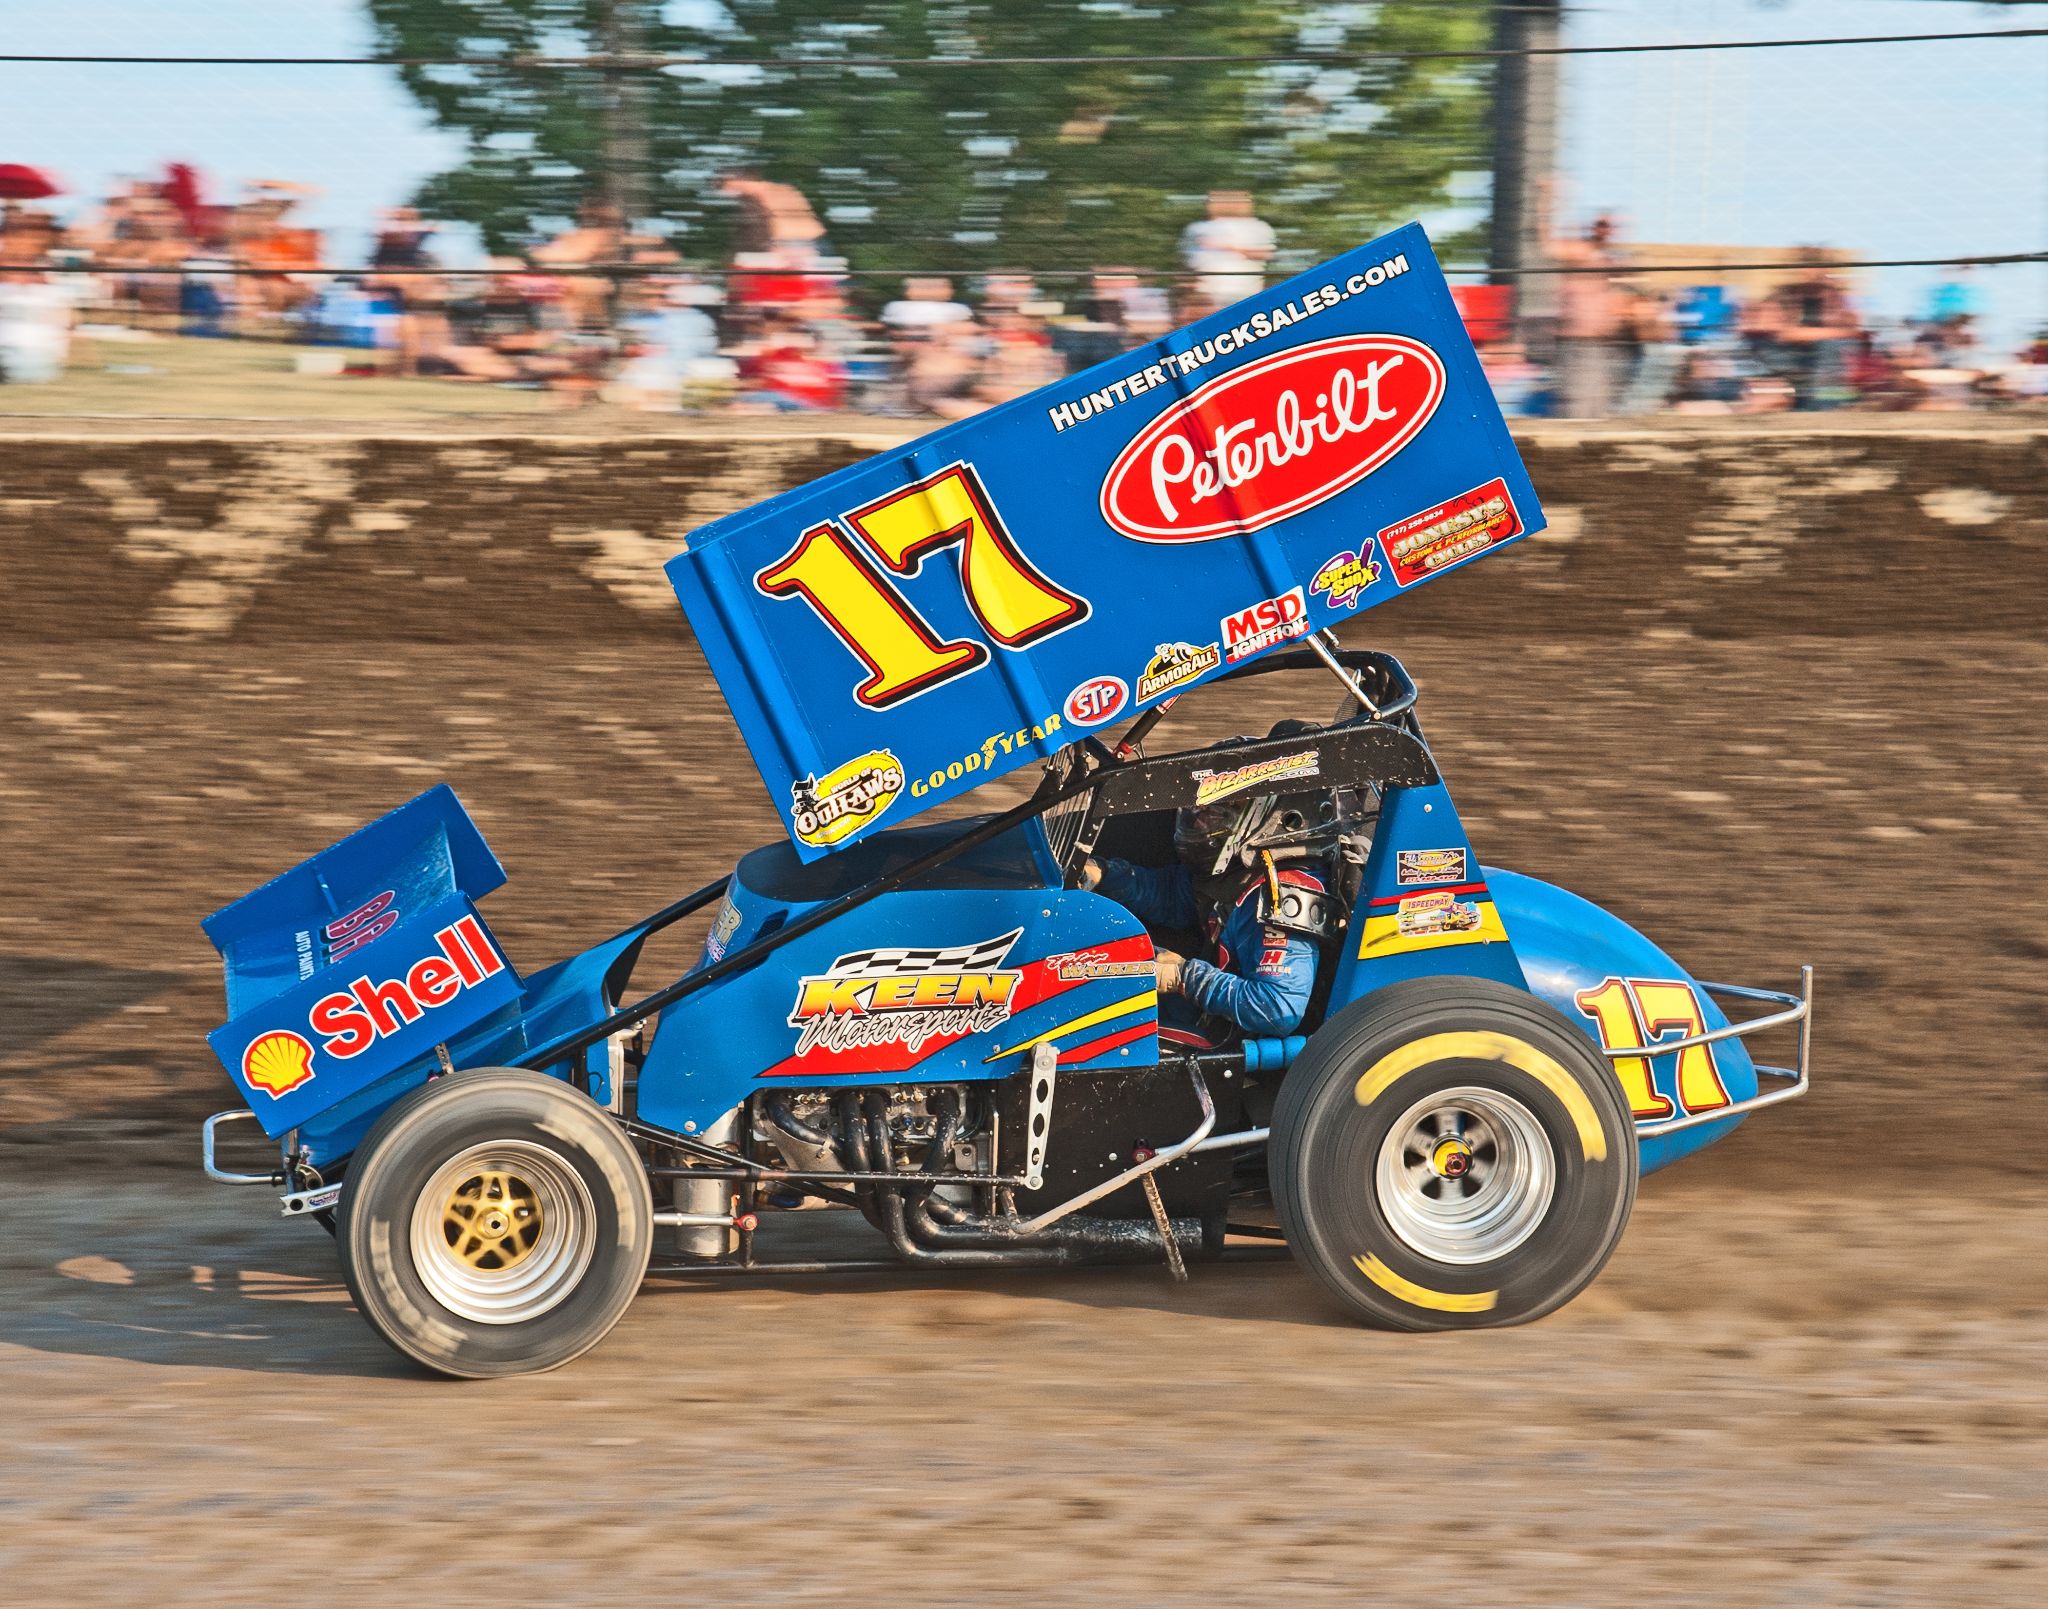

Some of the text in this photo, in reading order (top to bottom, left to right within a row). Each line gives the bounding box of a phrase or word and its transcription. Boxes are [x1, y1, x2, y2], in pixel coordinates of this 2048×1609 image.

[1048, 253, 1411, 433] HUNTERTRUCKSALES.COM
[1150, 354, 1405, 523] Peterbilt
[1399, 546, 1434, 567] CUSTOM
[1444, 512, 1508, 546] PERFORMANCE
[1424, 530, 1492, 569] CYCLES
[752, 458, 1094, 713] 17
[1318, 558, 1362, 590] SUPER
[1228, 593, 1301, 645] MSD
[1233, 618, 1305, 660] IGNITION
[1076, 683, 1117, 720] STP
[829, 766, 874, 794] WORLD OF
[910, 712, 1063, 798] GOODYEAR
[295, 930, 312, 952] AUTO
[309, 913, 505, 1060] Shell
[794, 973, 1018, 1020] KEEN
[1061, 963, 1155, 979] WALKER
[797, 1000, 1009, 1055] Motorsports
[1574, 976, 1733, 1123] 17
